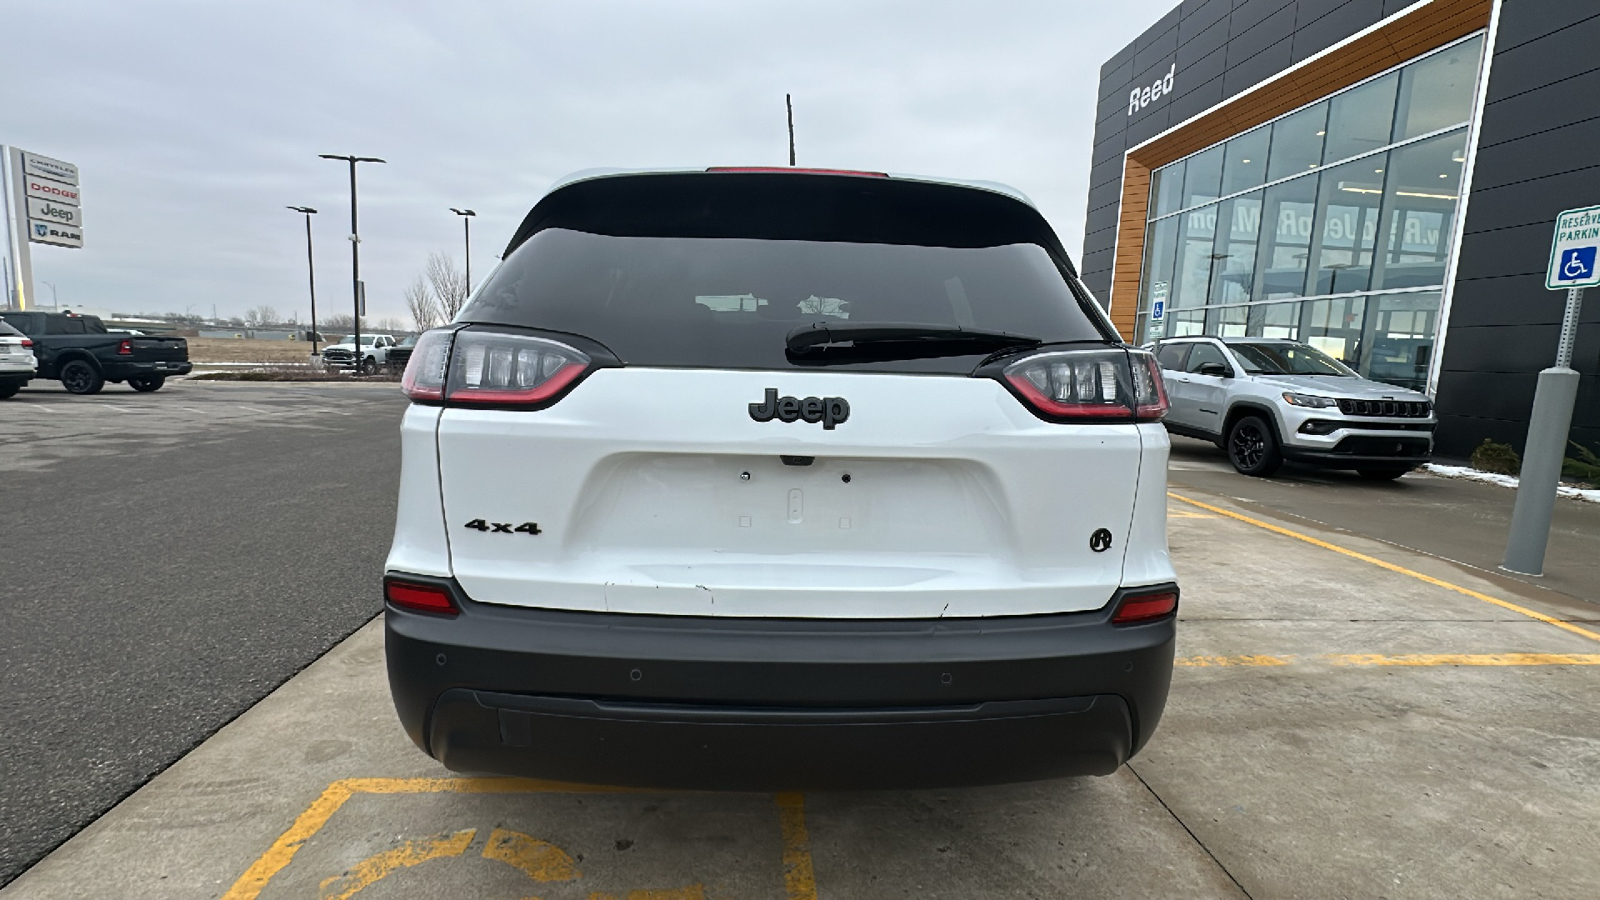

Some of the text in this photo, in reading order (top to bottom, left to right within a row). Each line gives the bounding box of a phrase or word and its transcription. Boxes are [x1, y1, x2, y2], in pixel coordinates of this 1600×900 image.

[1128, 63, 1176, 116] Reed
[31, 183, 78, 199] DODGE
[41, 203, 73, 222] Jeep
[50, 229, 81, 241] RAM
[1559, 227, 1600, 242] PARKIN
[748, 388, 850, 430] Jeep
[464, 518, 542, 536] 4x4
